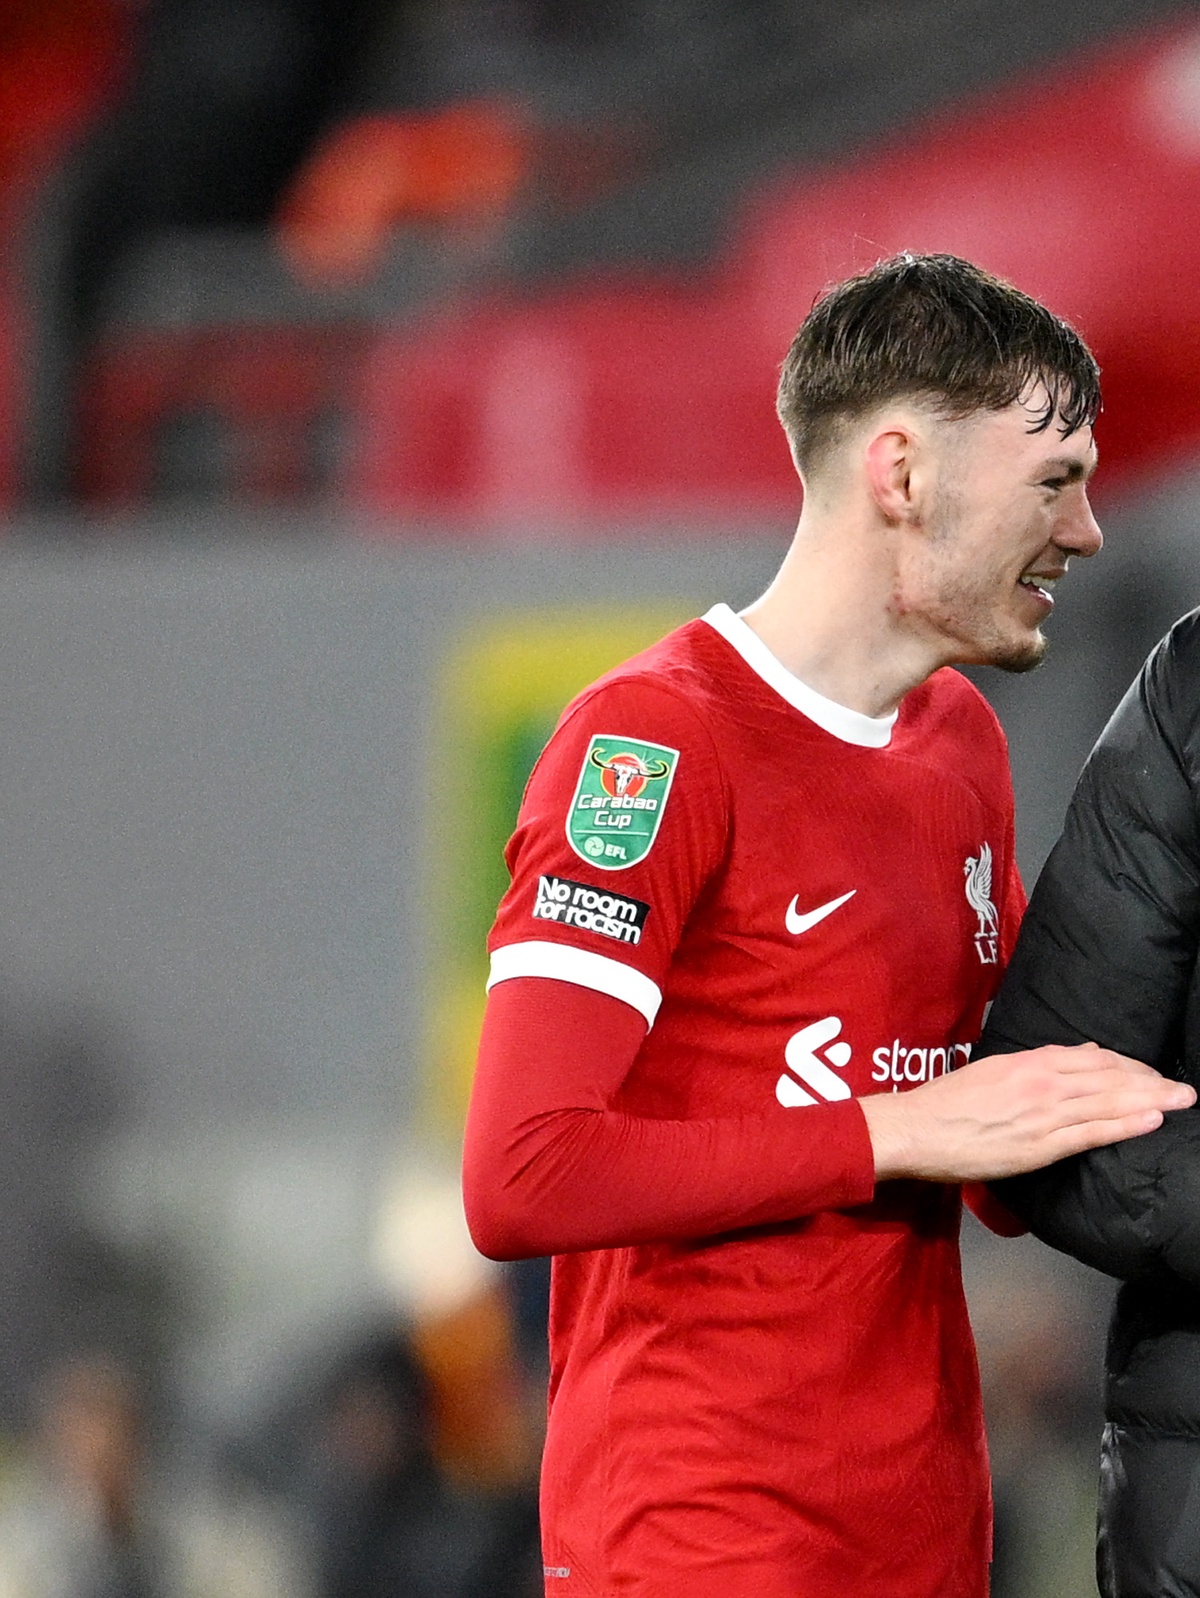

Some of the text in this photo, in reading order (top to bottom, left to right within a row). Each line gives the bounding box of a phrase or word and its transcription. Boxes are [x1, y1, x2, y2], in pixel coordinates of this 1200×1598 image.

[578, 794, 657, 810] Carabao
[594, 811, 631, 828] Cup
[605, 844, 627, 859] EFL
[537, 875, 637, 922] No room
[533, 896, 640, 944] for racism
